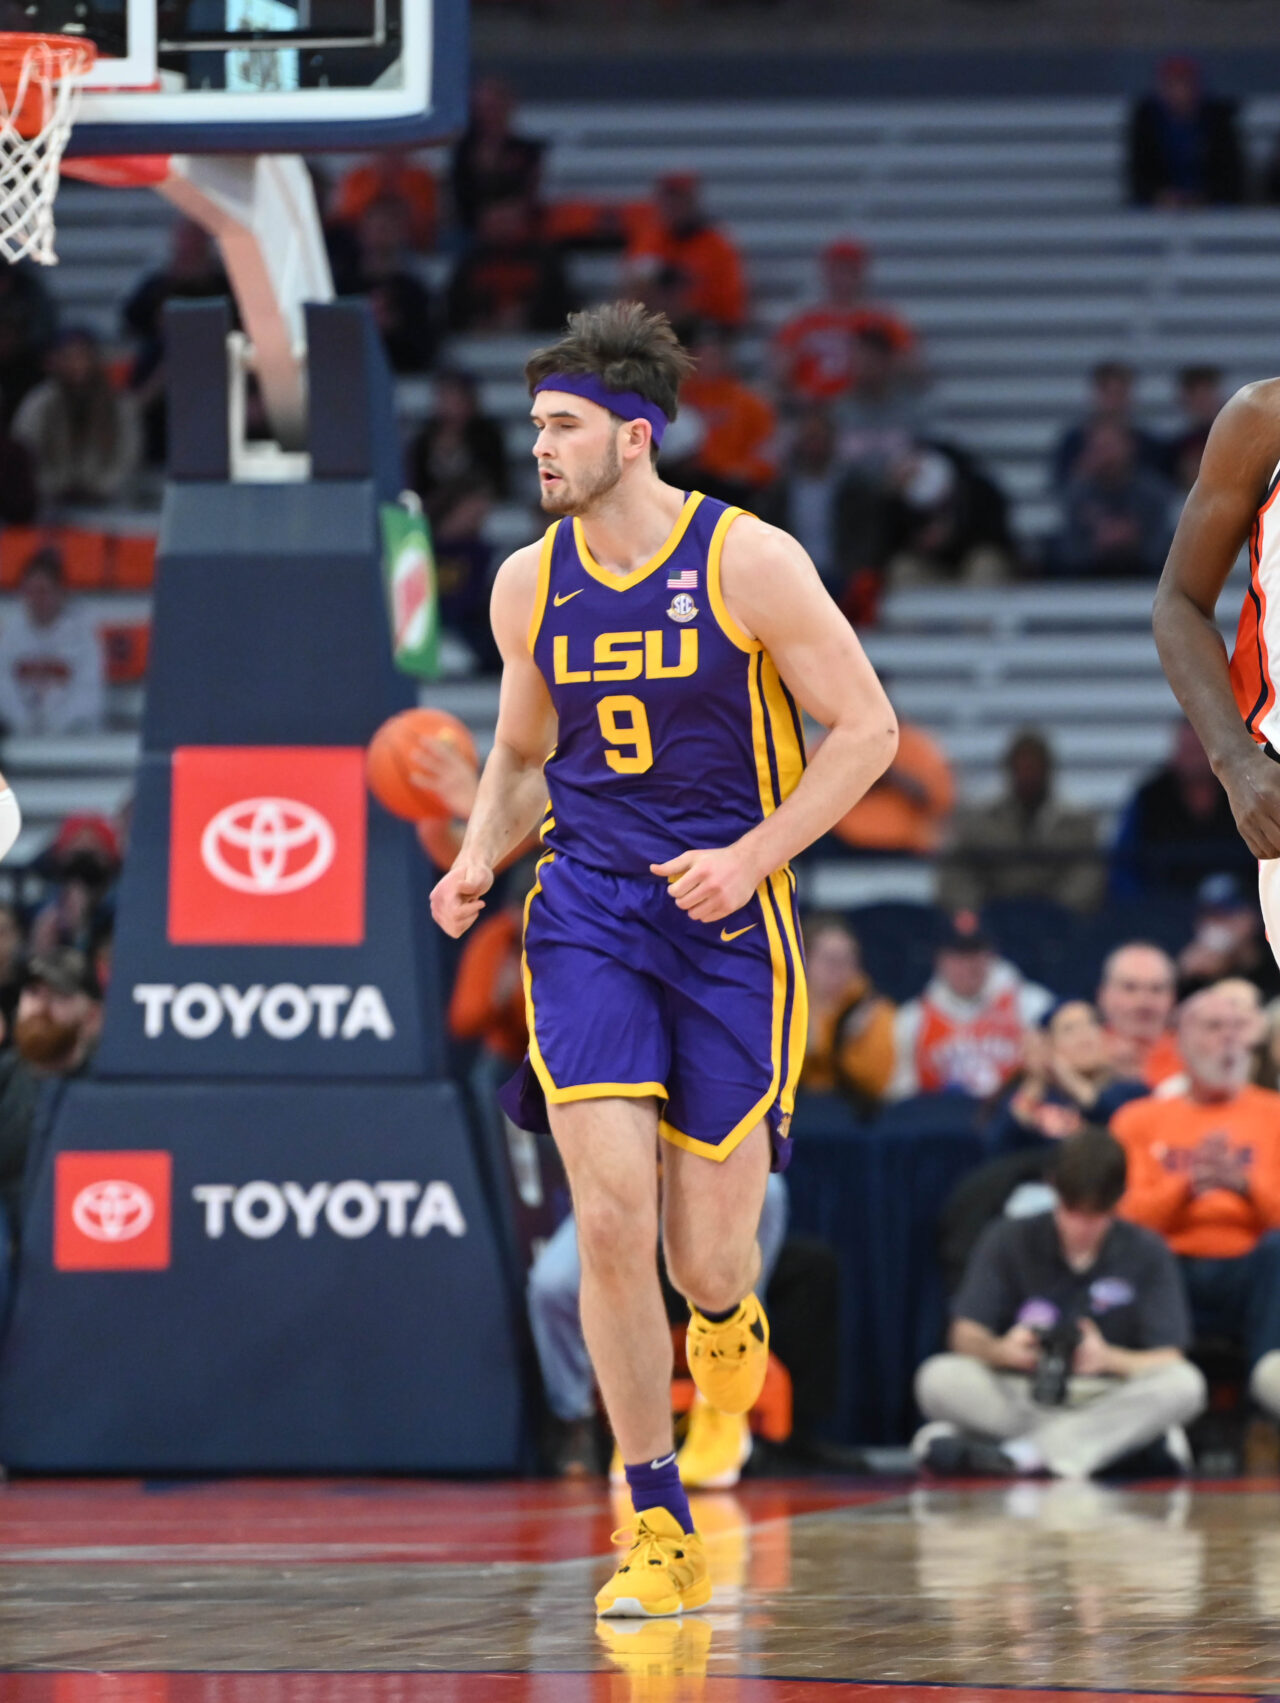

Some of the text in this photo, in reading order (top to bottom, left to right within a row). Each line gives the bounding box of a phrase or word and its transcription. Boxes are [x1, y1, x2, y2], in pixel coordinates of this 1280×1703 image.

[672, 595, 693, 615] SEC
[553, 628, 699, 685] LSU
[596, 694, 654, 775] 9
[132, 982, 396, 1040] TOYOTA
[191, 1180, 466, 1239] TOYOTA
